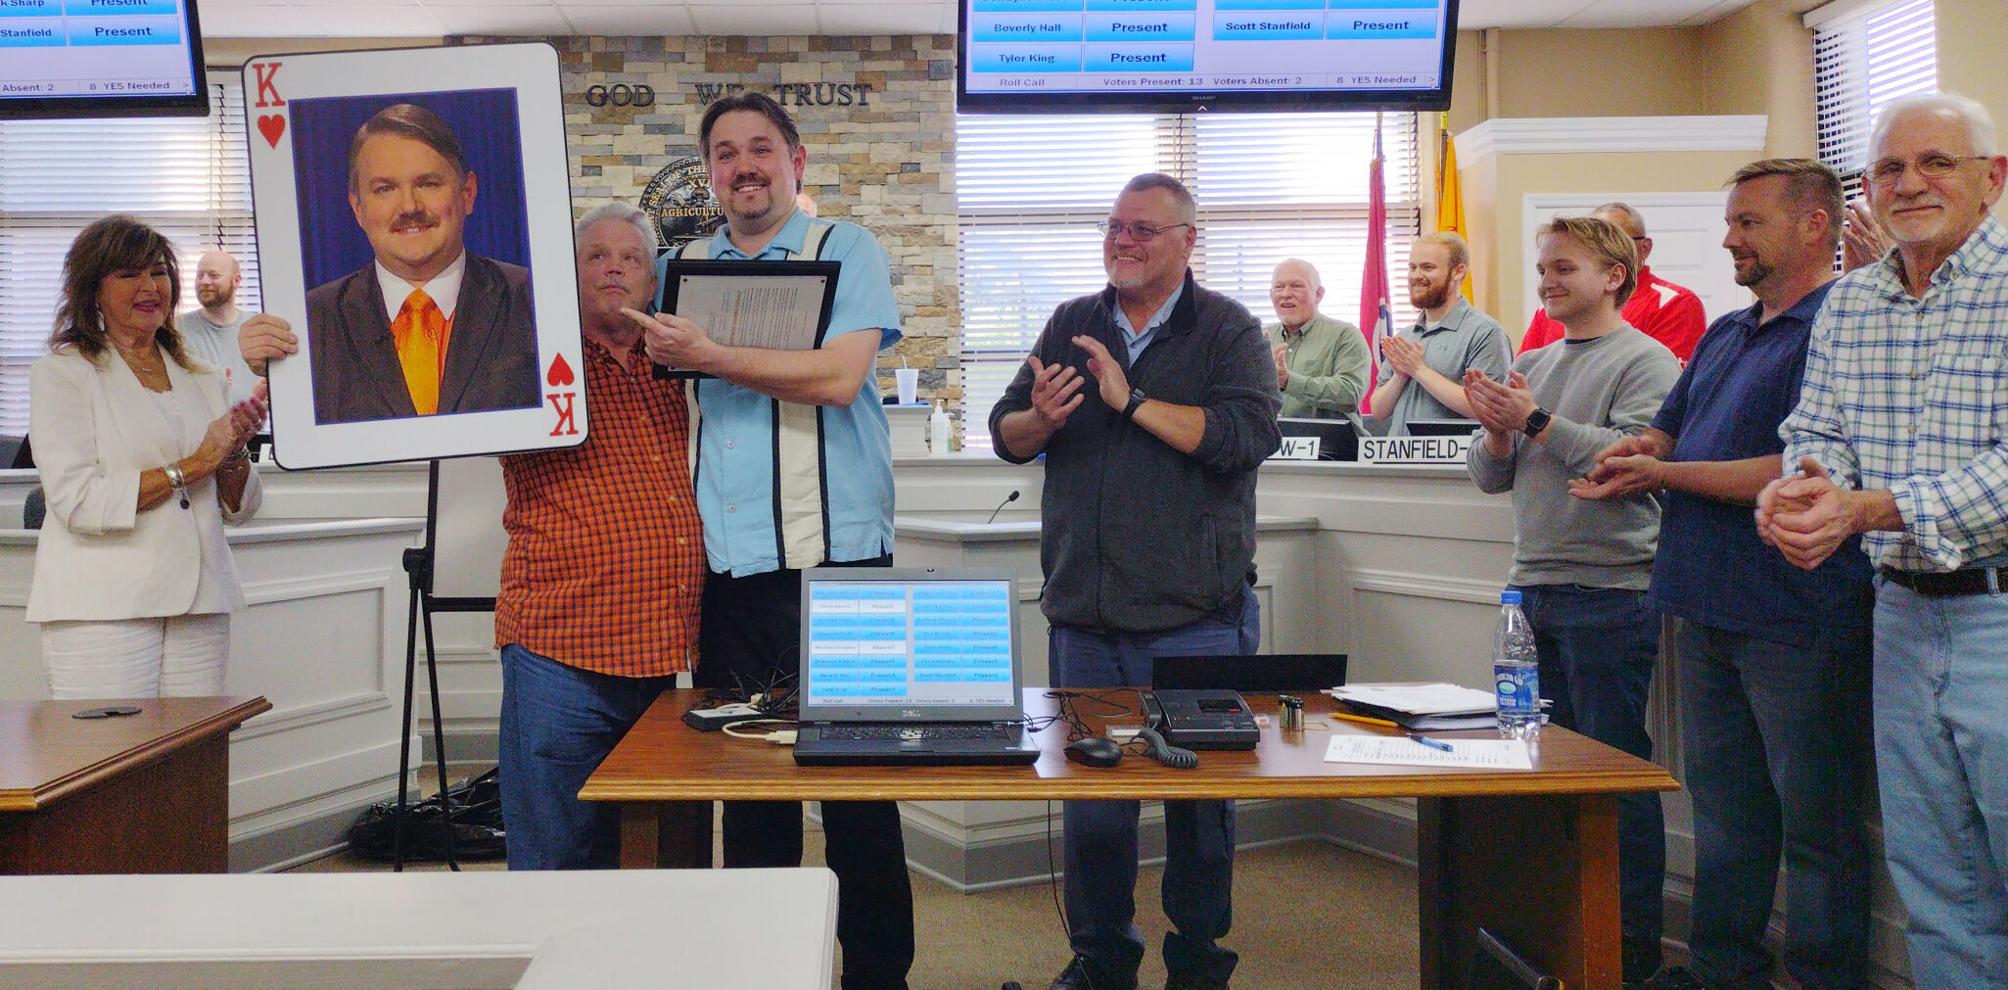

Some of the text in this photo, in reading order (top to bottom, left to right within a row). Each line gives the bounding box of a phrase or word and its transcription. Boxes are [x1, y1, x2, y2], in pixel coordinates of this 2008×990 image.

[994, 23, 1036, 34] Beverly
[1039, 23, 1061, 32] Hall
[1111, 22, 1168, 33] Present
[1225, 22, 1256, 31] Scott
[1259, 21, 1311, 31] Stanfield
[1352, 20, 1410, 31] Present
[0, 28, 52, 37] Stanfield
[94, 26, 153, 37] Present
[1029, 54, 1055, 64] King
[1110, 53, 1167, 63] Present
[252, 62, 287, 108] K
[999, 78, 1045, 87] Roll Call
[1103, 77, 1203, 87] Voters Present: 13
[1213, 76, 1302, 86] Voters Absent: 2
[1336, 75, 1417, 85] 8 YES Needed
[2, 83, 55, 92] Absent: 2
[89, 81, 170, 91] 8 YES Needed
[585, 83, 656, 107] GOD
[773, 83, 872, 106] TRUST
[660, 207, 724, 218] AGRICULTU
[547, 392, 579, 437] K
